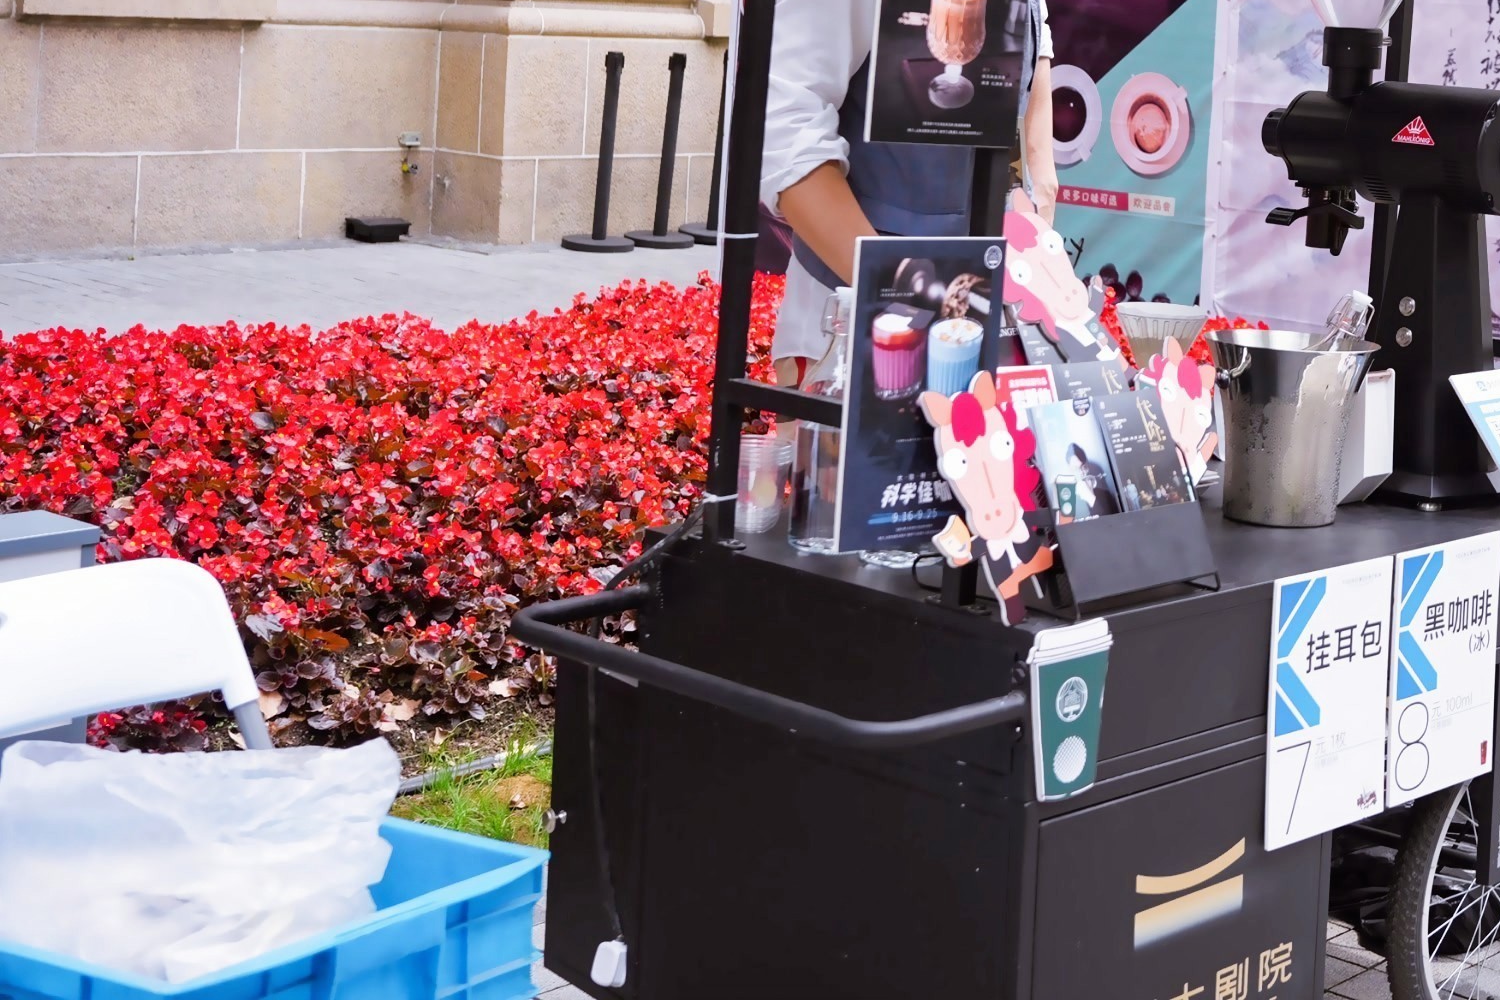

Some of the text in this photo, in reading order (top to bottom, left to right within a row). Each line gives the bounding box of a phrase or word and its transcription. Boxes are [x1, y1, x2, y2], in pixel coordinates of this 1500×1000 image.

[1424, 590, 1493, 642] 黑咖啡
[1468, 630, 1490, 654] (冰)
[1306, 619, 1383, 674] 挂耳包
[1395, 701, 1429, 791] 8
[1277, 740, 1311, 835] 7
